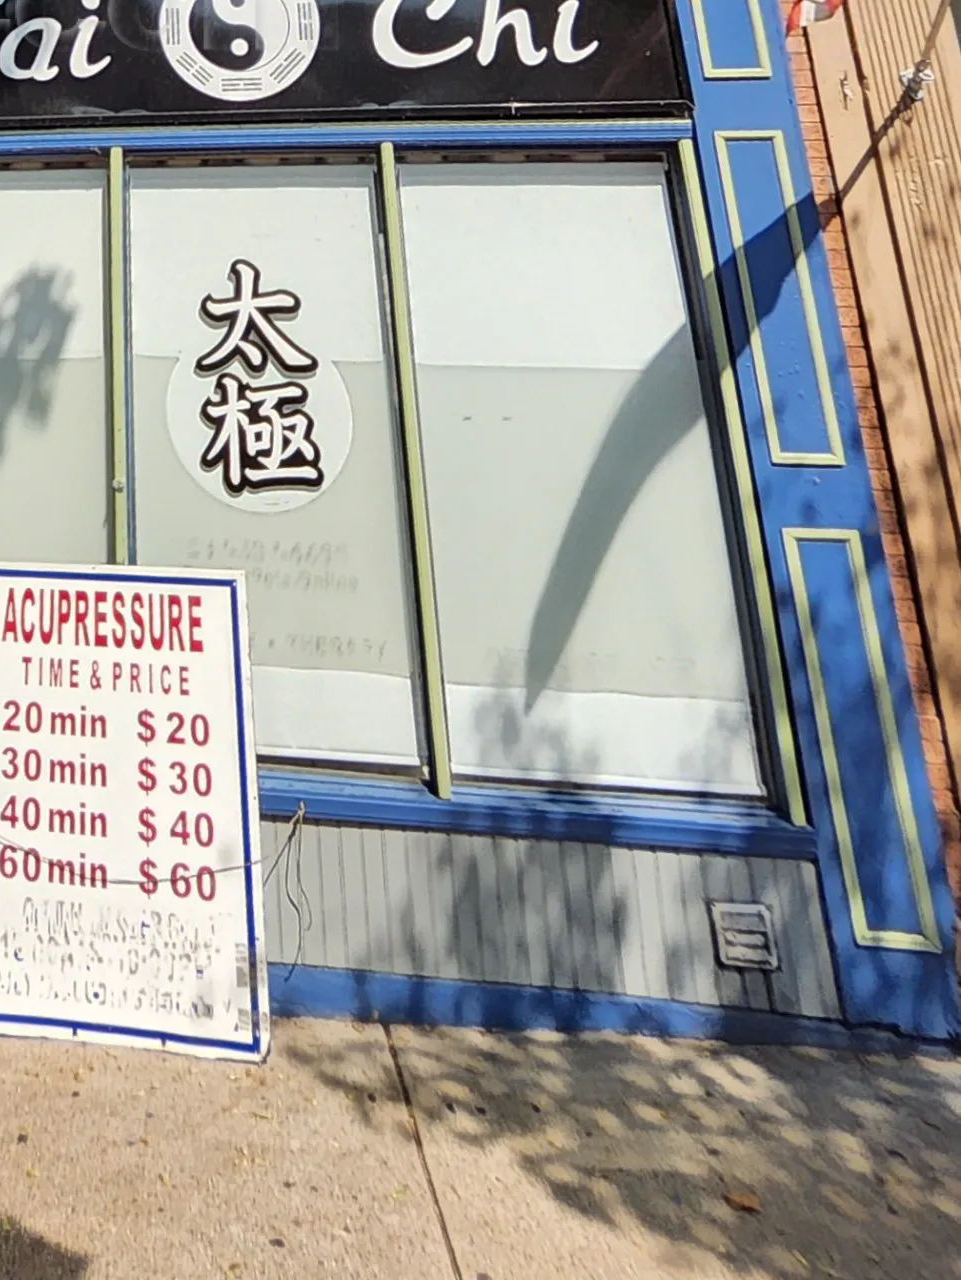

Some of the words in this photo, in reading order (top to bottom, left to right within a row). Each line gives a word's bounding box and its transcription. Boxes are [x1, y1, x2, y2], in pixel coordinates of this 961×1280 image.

[194, 258, 325, 496] 太極
[2, 587, 205, 654] ACUPRESSURE
[22, 655, 79, 689] TIME
[90, 662, 103, 691] &
[112, 663, 191, 697] PRICE
